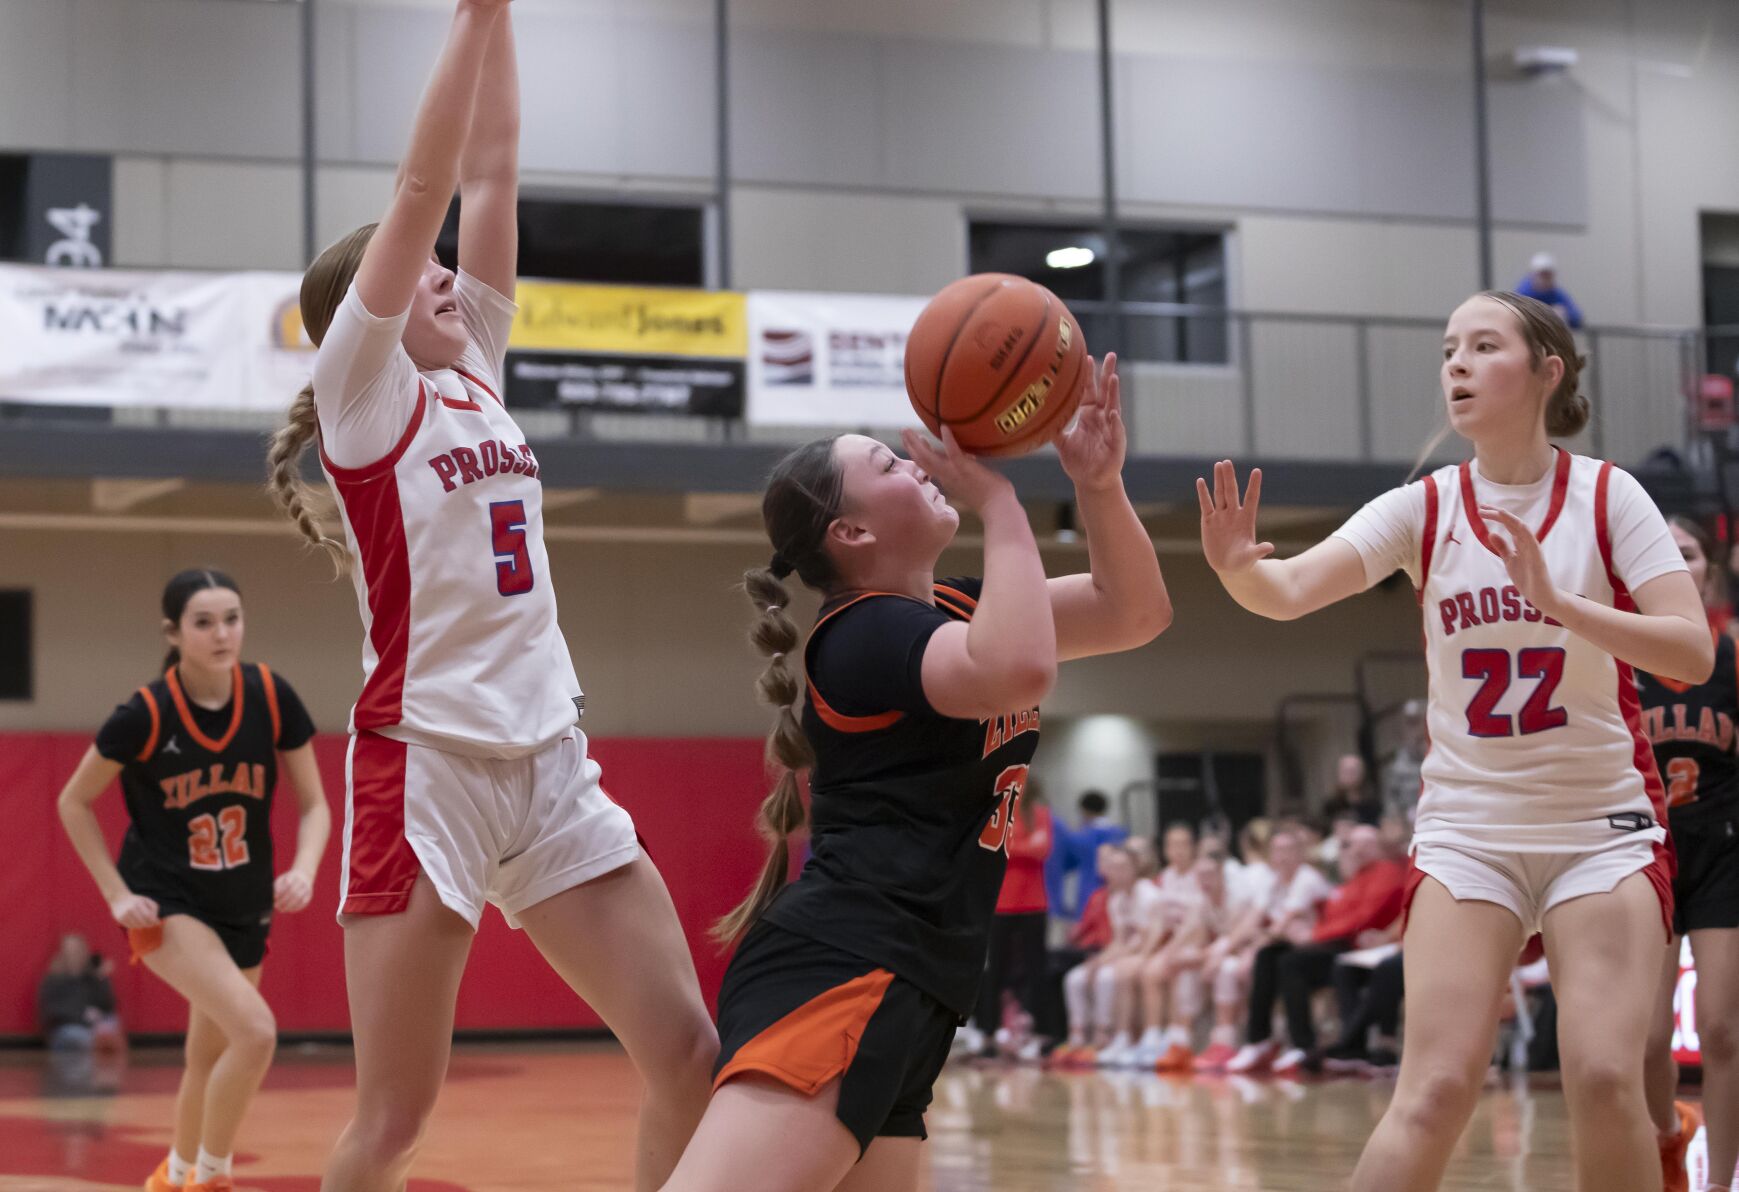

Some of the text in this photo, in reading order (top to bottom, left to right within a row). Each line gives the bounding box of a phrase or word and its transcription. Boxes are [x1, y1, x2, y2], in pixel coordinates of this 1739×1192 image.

[428, 440, 541, 493] PROSSE
[489, 499, 534, 597] 5
[1438, 585, 1564, 636] PROSS
[1461, 646, 1568, 738] 22
[1666, 756, 1700, 809] 2
[187, 804, 250, 871] 22
